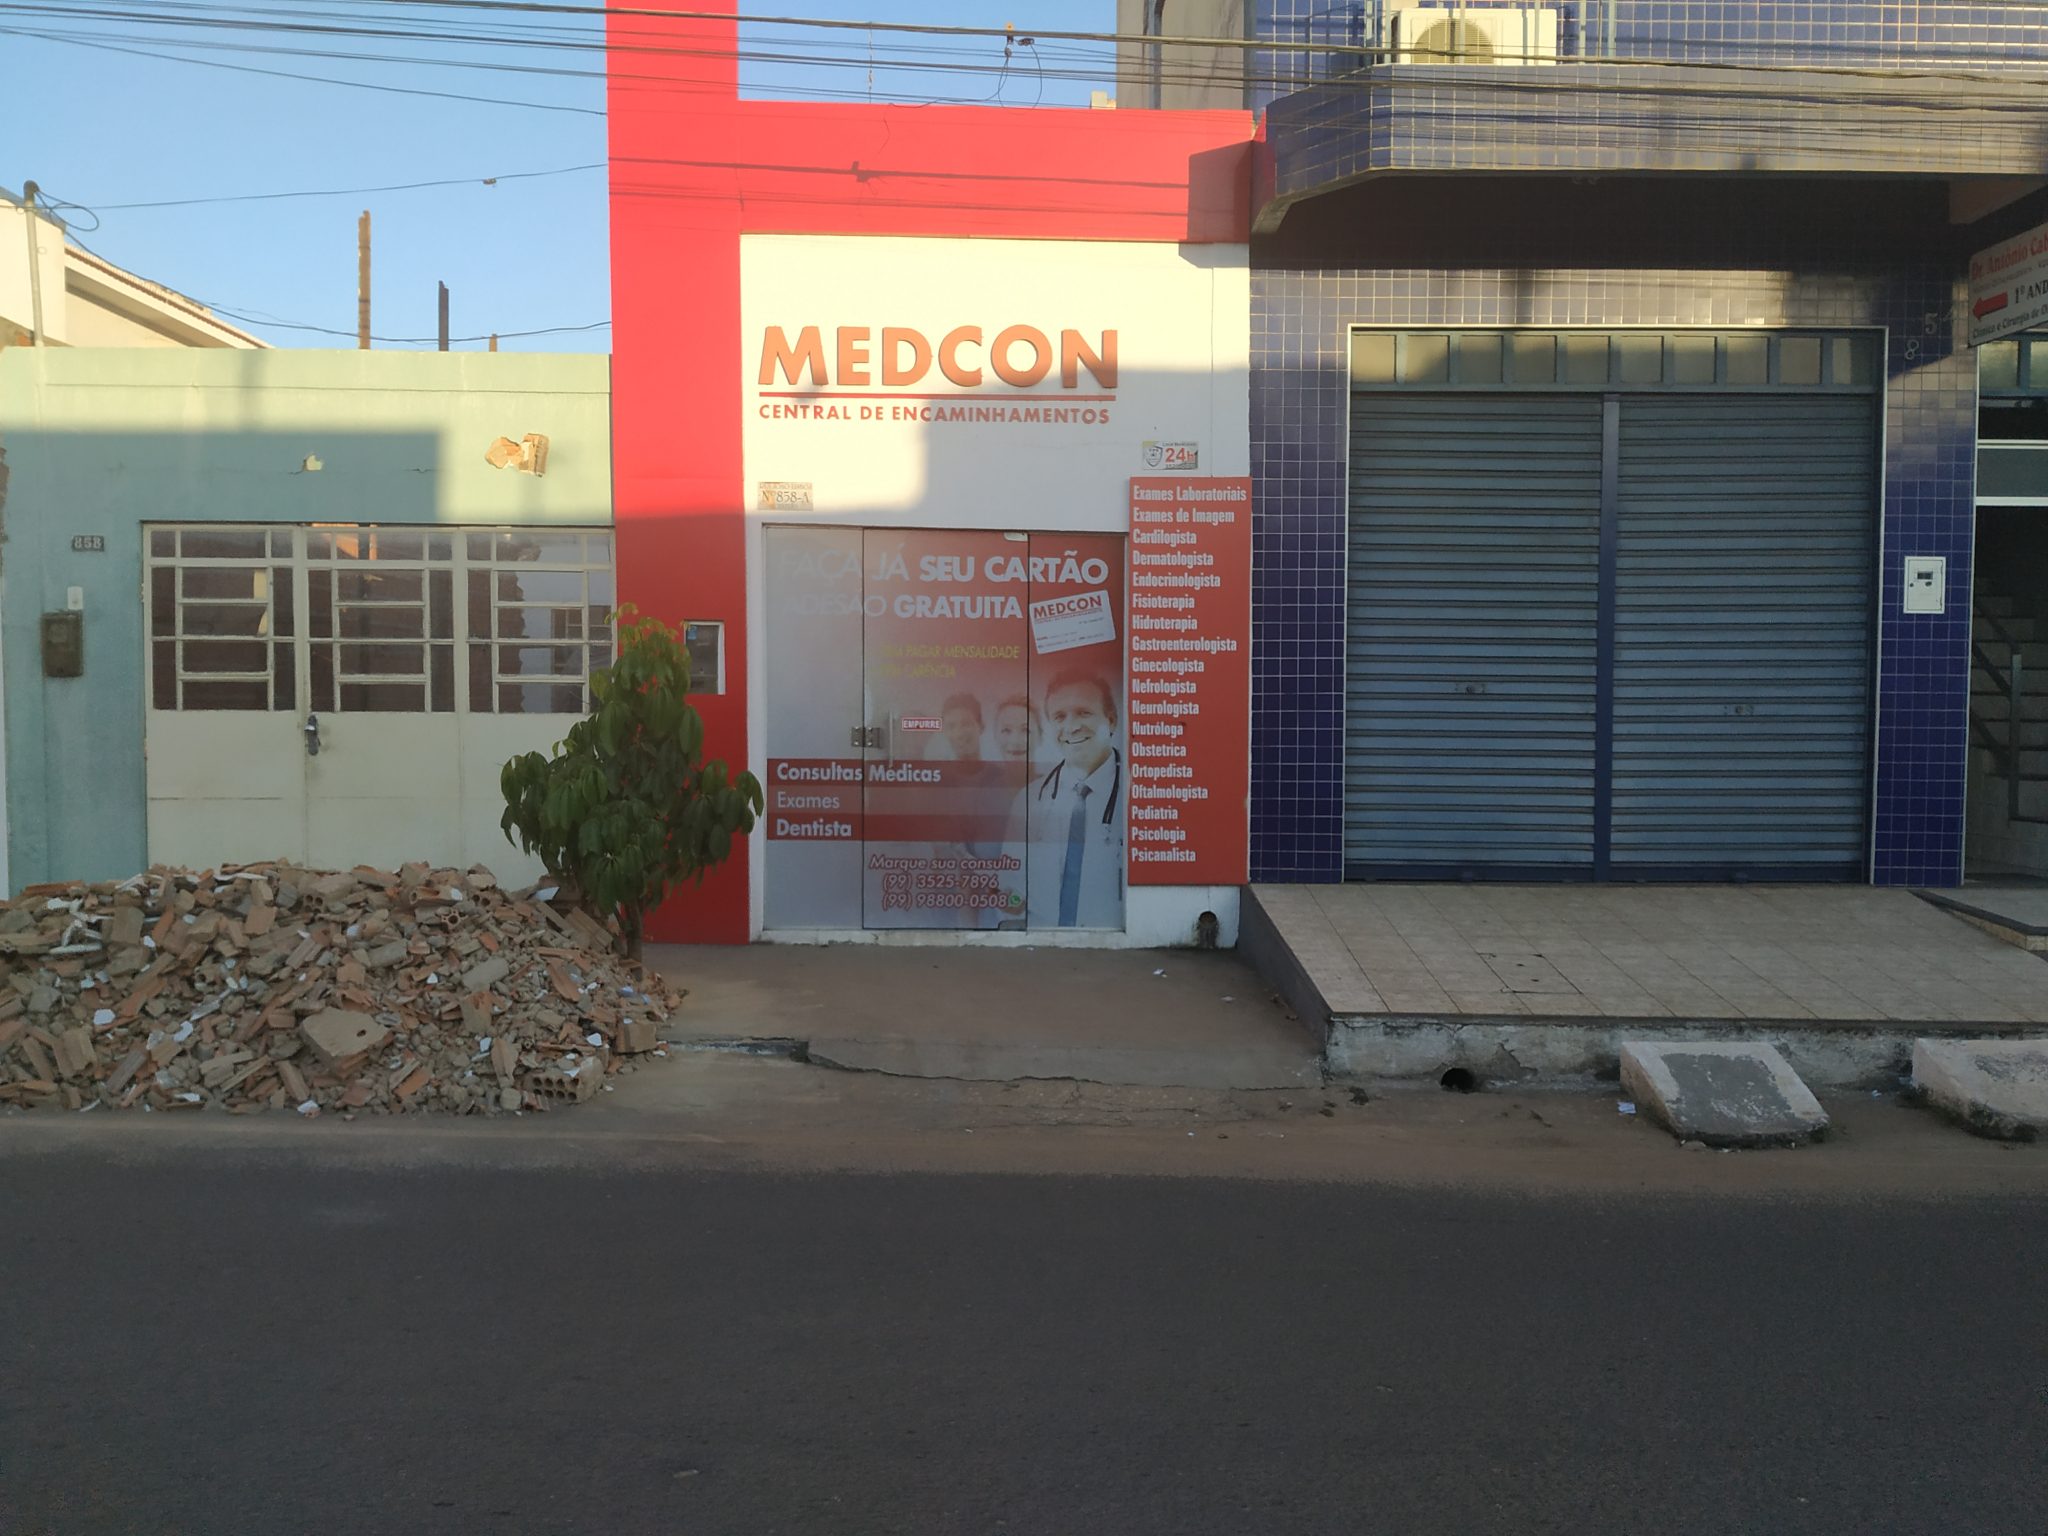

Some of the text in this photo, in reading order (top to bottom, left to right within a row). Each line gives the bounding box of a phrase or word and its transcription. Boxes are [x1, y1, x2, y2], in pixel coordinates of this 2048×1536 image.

[758, 324, 1118, 388] MEDCON
[759, 404, 1110, 424] CENTRAL DE ENCAMINHAMENTOS
[1133, 485, 1247, 501] Exames Laboratoriais
[1133, 507, 1235, 526] Exames de Imagem
[872, 542, 910, 581] JÁ
[919, 555, 975, 582] SEU
[984, 550, 1109, 585] CARTÃO
[1132, 551, 1214, 568] Dermatologista
[1132, 572, 1221, 590] Endocrinologista
[893, 595, 1023, 619] GRATUITA
[1033, 595, 1102, 619] MEDCON
[1132, 593, 1195, 611] Fisioterapia
[1132, 615, 1197, 632] Hidroterapia
[1132, 636, 1237, 654] Gastroenterologista
[1132, 657, 1205, 675] Ginecologista
[1132, 679, 1197, 696] Nefrologista
[1132, 700, 1199, 717] Neurologista
[903, 719, 940, 729] EMPURRE
[777, 762, 863, 781] Consultas
[1131, 763, 1193, 780] Ortopedista
[777, 791, 840, 809] Exames
[1132, 784, 1208, 801] Oftalmologista
[1131, 806, 1178, 820] Pediatria
[776, 818, 852, 837] Dentista
[1131, 826, 1186, 844] Psicologia
[870, 854, 1021, 872] Marque sua consulta
[1131, 847, 1196, 862] Psicanalista
[883, 873, 999, 890] (99) 3525-7896
[882, 893, 1008, 910] (99) 98800-0508
